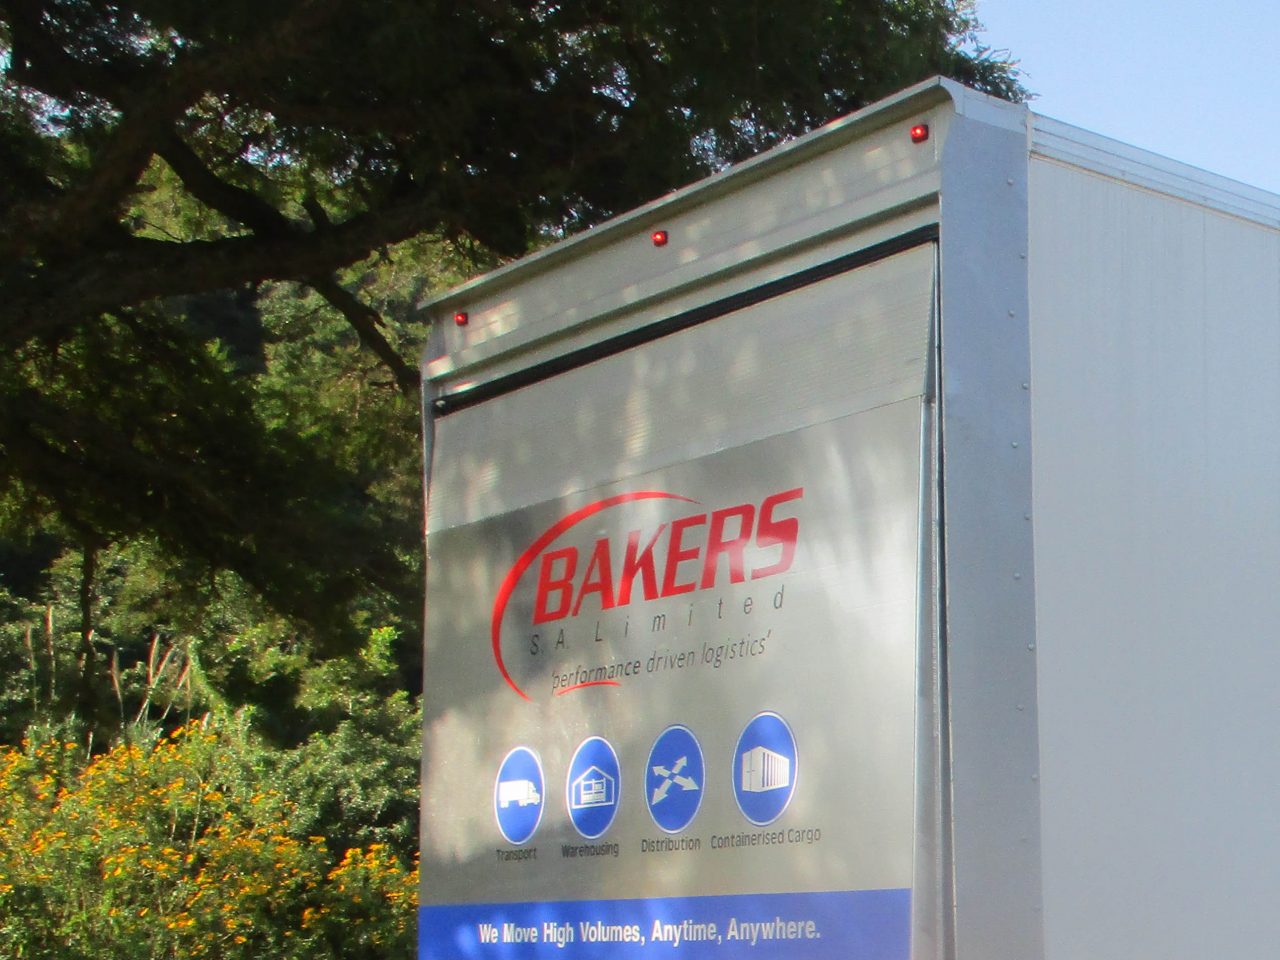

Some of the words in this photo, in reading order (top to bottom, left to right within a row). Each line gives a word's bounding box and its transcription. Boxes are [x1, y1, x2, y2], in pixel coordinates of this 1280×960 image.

[532, 487, 804, 626] BAKERS
[594, 584, 785, 643] Limited
[646, 648, 696, 673] driven
[561, 840, 620, 859] Warehousing
[641, 837, 701, 853] Distribution
[710, 829, 785, 850] Containerised
[787, 827, 822, 846] Cargo
[496, 846, 538, 863] Transport
[479, 923, 499, 944] We
[502, 922, 539, 944] Move
[542, 921, 575, 948] High
[579, 920, 646, 946] Volumes,
[650, 919, 723, 948] Anytime,
[727, 917, 822, 946] Anywhere.
